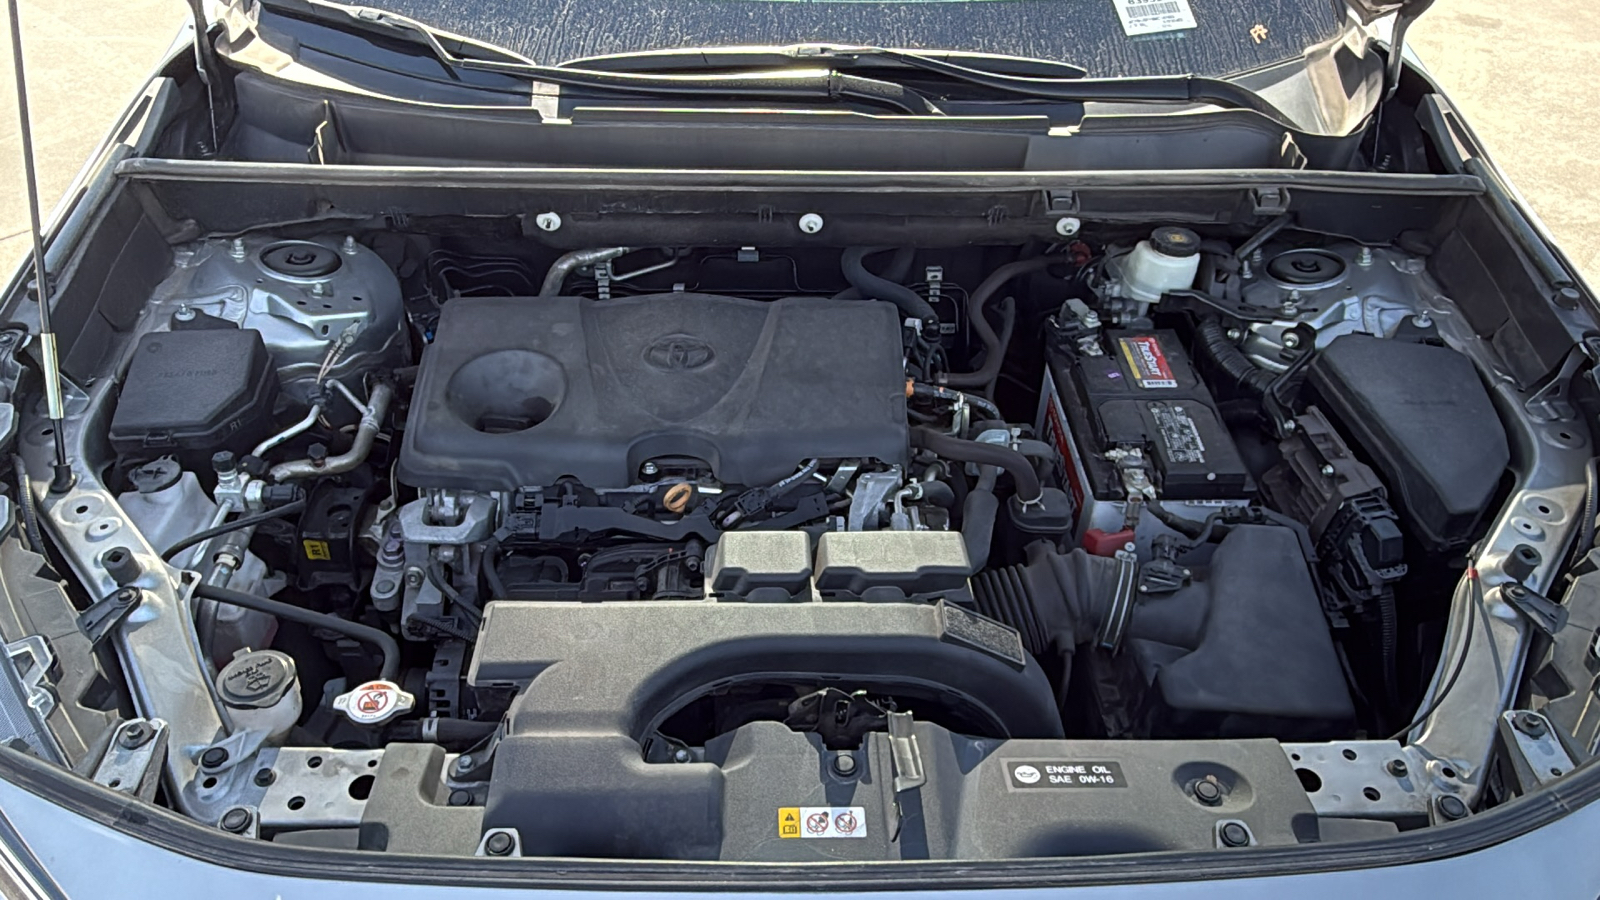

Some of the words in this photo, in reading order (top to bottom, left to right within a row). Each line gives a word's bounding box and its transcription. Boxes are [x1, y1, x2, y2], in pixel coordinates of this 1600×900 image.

[1045, 765, 1087, 774] ENGINE
[1091, 765, 1112, 774] OIL
[1048, 775, 1073, 783] SAE
[1078, 775, 1115, 783] 0W-16
